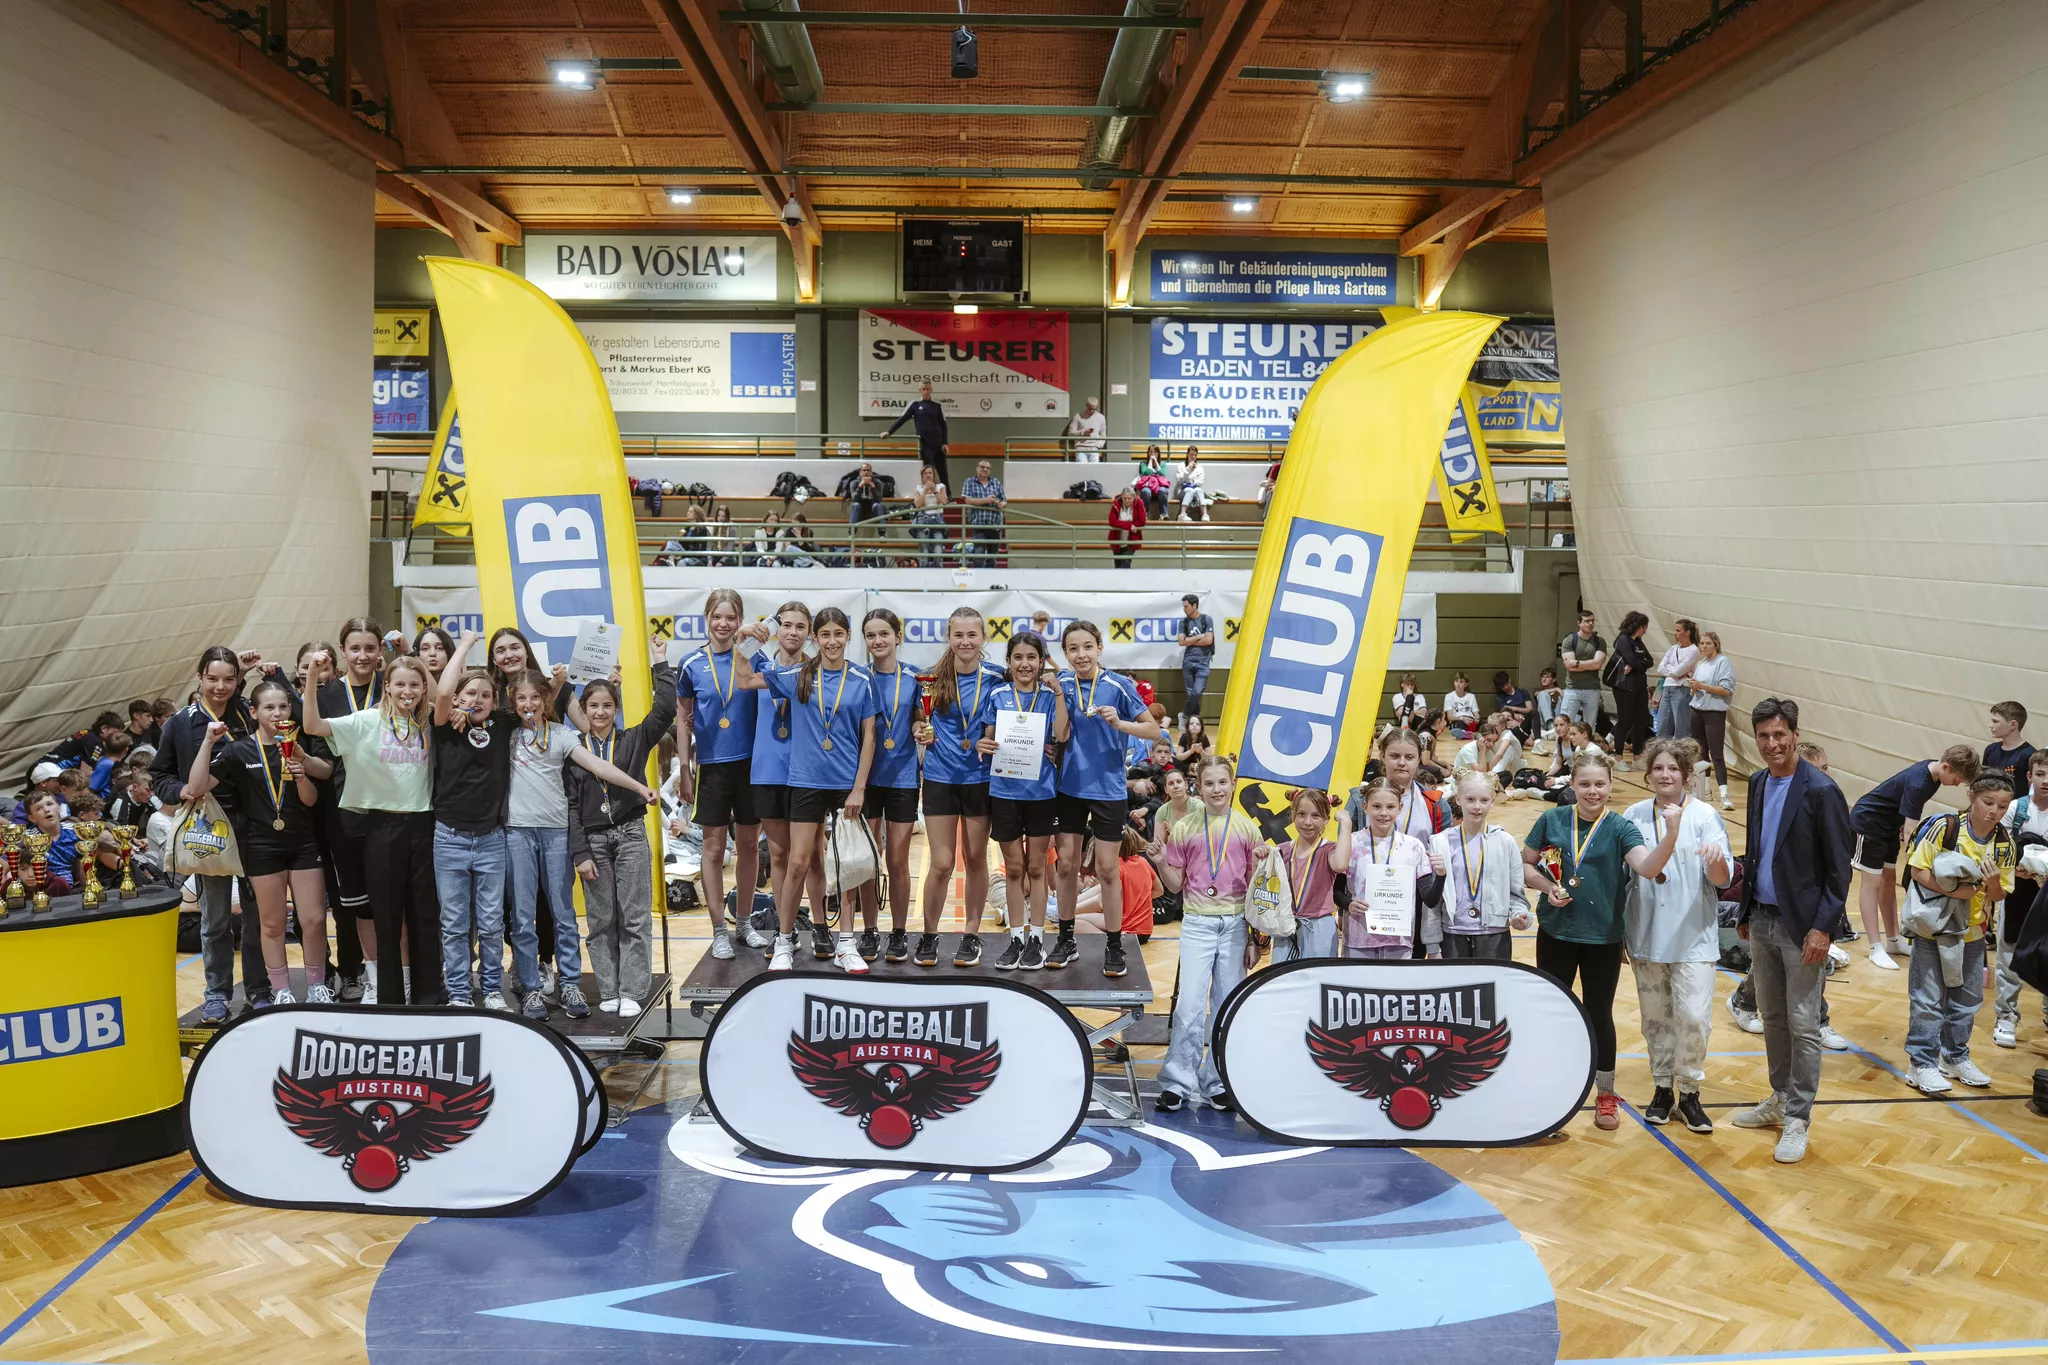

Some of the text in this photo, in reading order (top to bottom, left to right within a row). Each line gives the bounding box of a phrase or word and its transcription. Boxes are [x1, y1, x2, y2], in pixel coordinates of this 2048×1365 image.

[556, 245, 622, 276] BAD
[1161, 259, 1180, 274] Wir
[1219, 260, 1235, 275] Ihr
[1239, 261, 1388, 280] Gebäudereinigungsproblem
[584, 281, 718, 290] WO GUTES LEBEN LEICHTER GEHT
[1161, 278, 1387, 297] und übernehmen die Pflege Ihres Gartens
[373, 326, 391, 335] den
[870, 316, 1058, 329] BAUMEISTER
[602, 335, 649, 351] gestalten
[653, 335, 721, 349] Lebensräume
[1486, 329, 1556, 349] OOMZ
[609, 354, 693, 363] Pflasterermeister
[782, 333, 795, 385] PFLASTER
[872, 339, 1056, 362] STEURER
[1481, 347, 1556, 358] NANCIALSERVICES
[630, 365, 666, 374] Markus
[669, 365, 695, 374] Ebert
[697, 366, 712, 374] KG
[1180, 359, 1252, 378] BADEN
[870, 371, 1059, 385] Baugesellschaft m.b.H.
[373, 373, 419, 406] gic
[732, 385, 794, 397] EBERT
[373, 411, 417, 425] eme
[1169, 405, 1224, 418] Chem.
[1228, 405, 1282, 419] techn.
[1483, 416, 1516, 426] LAND
[674, 617, 709, 640] CL
[904, 619, 951, 642] CLU
[1135, 619, 1180, 642] CLU
[1392, 620, 1420, 642] UB
[583, 645, 611, 656] URKUNDE
[1251, 533, 1370, 777] CLUB
[1004, 738, 1035, 746] URKUNDE
[1326, 989, 1491, 1031] DODGEBALL
[810, 1000, 982, 1050] DODGEBALL
[1373, 1028, 1446, 1042] AUSTRIA
[297, 1036, 475, 1087] DODGEBALL
[855, 1046, 933, 1061] AUSTRIA
[343, 1081, 424, 1098] AUSTRIA
